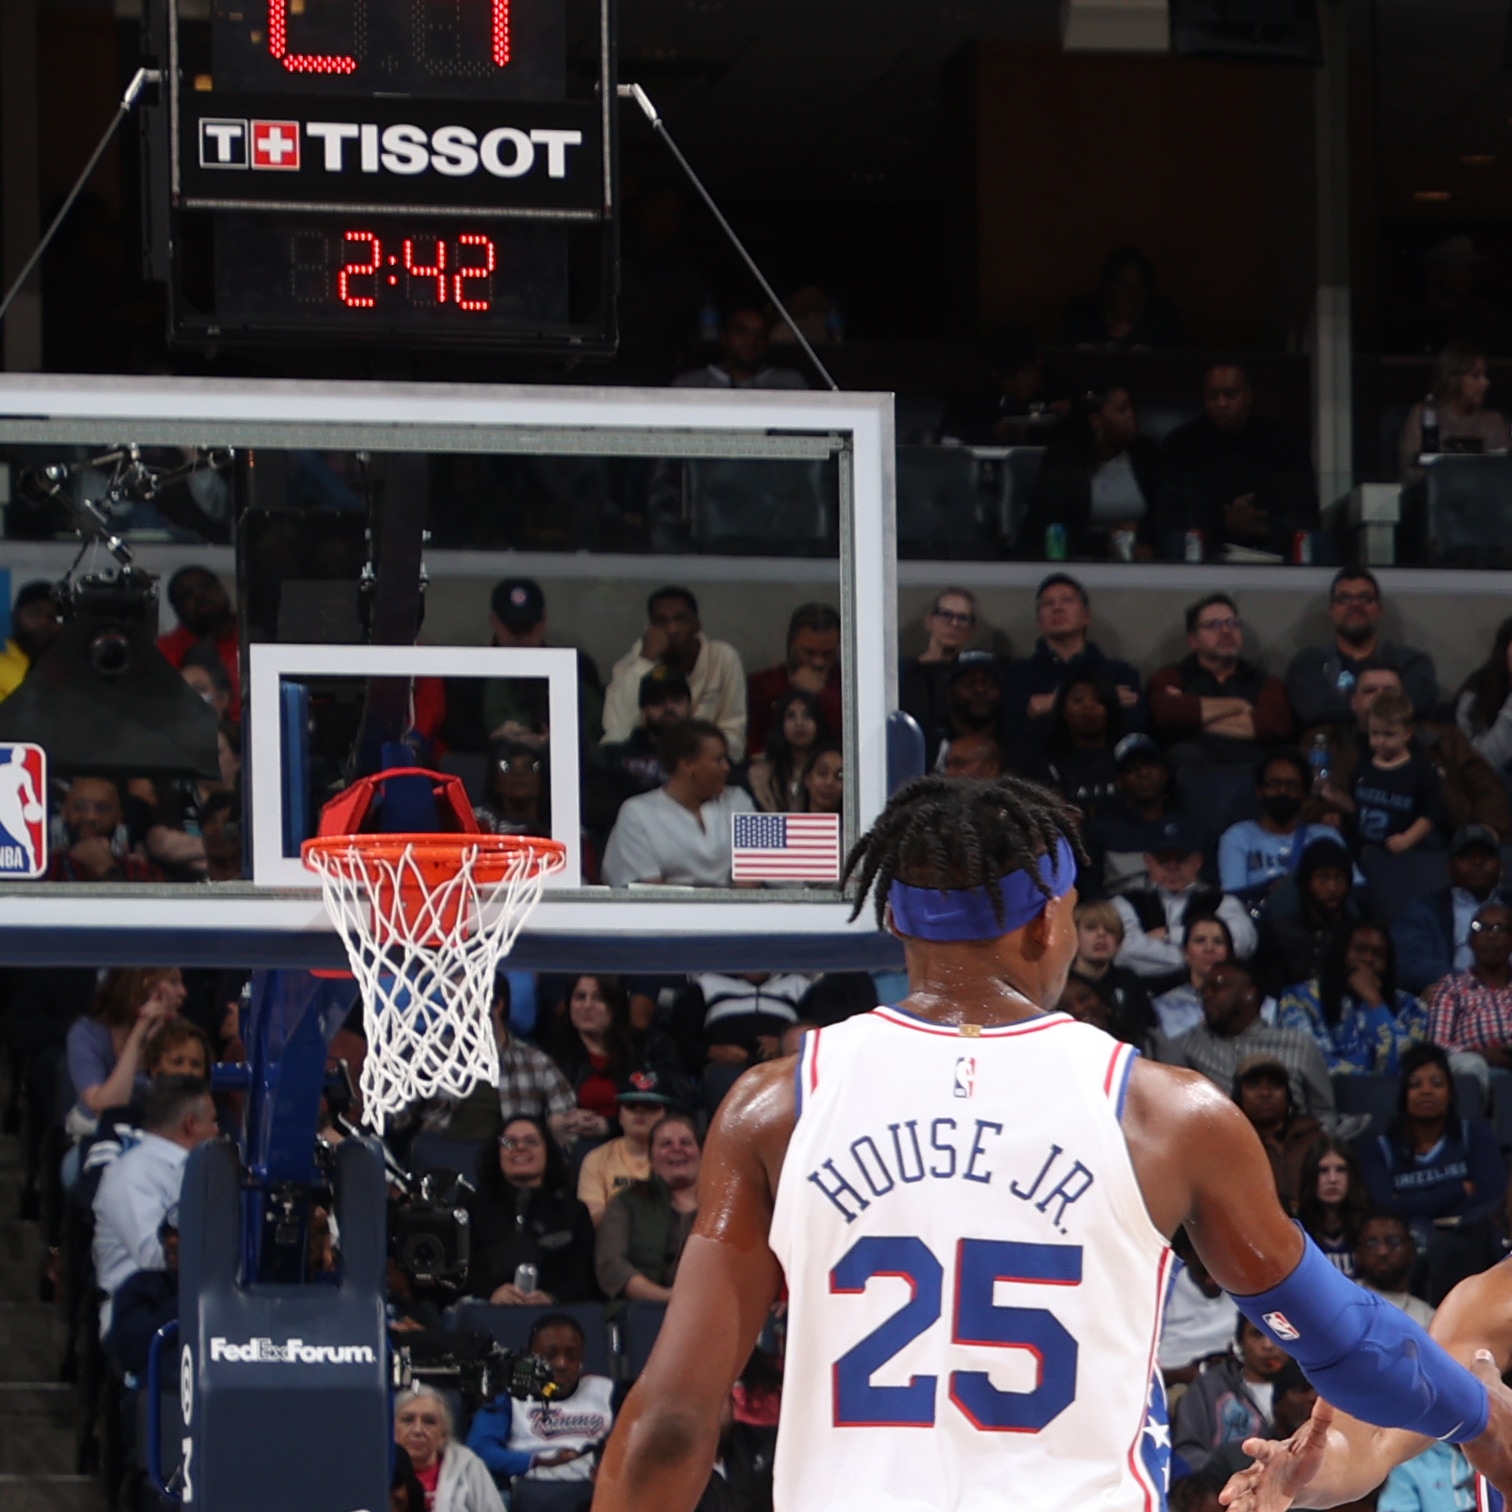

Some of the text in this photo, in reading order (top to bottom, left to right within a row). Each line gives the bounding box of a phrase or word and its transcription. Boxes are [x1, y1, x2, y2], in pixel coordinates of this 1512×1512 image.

[306, 122, 582, 178] TISSOT
[338, 231, 496, 311] 2:42
[808, 1118, 1095, 1235] HOUSE JR.
[210, 1338, 376, 1364] FedExForum
[828, 1235, 1084, 1434] 25
